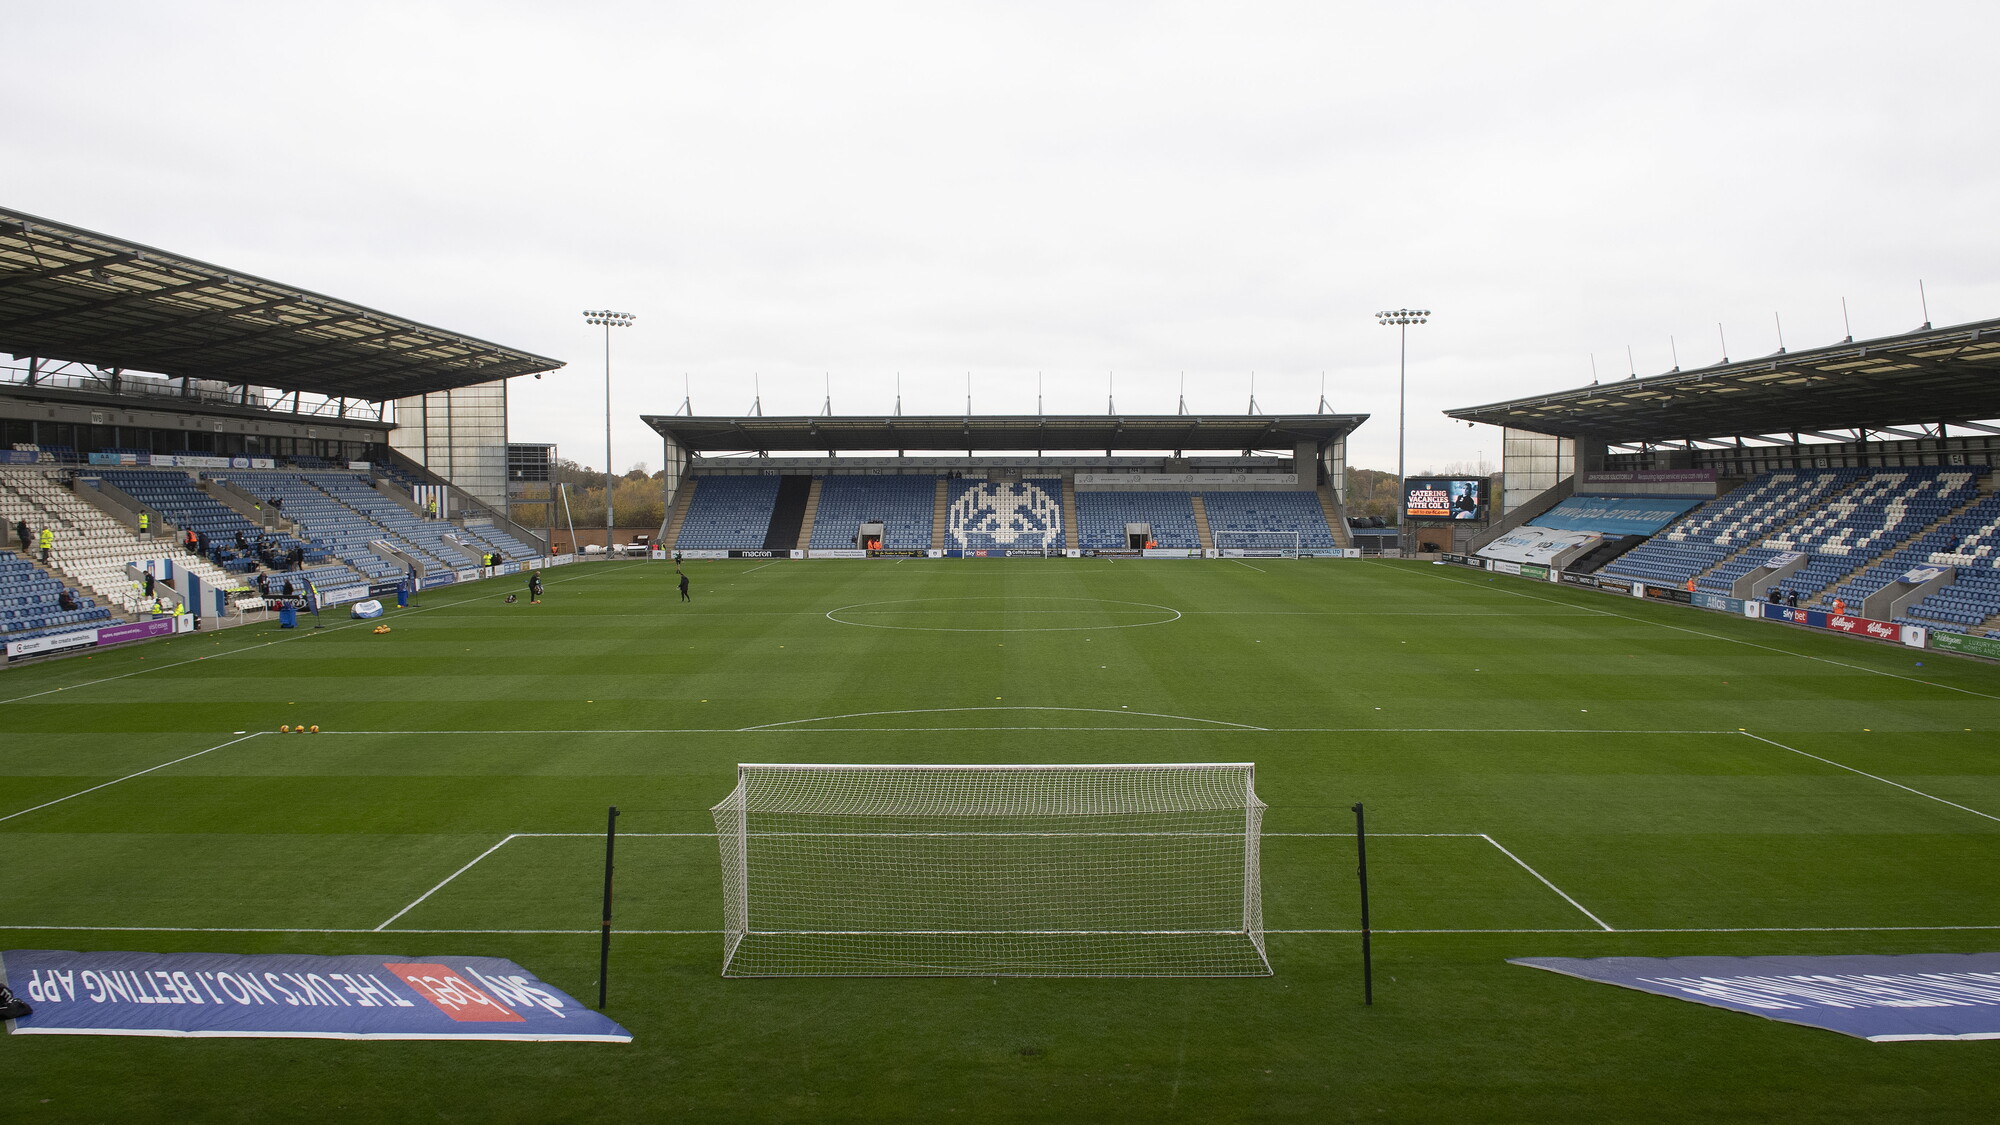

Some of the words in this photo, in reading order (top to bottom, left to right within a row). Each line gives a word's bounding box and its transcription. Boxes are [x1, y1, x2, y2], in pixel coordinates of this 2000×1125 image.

[1953, 454, 1963, 463] E4
[1706, 596, 1726, 610] Atlas
[1783, 609, 1794, 620] sky
[1795, 611, 1806, 621] bet
[1831, 616, 1856, 631] Kellogg's
[1867, 622, 1893, 637] Kellogg's
[1963, 644, 1982, 653] HOMES
[28, 969, 76, 1003] APP
[81, 970, 205, 1005] BETTING
[265, 973, 351, 1007] UK'S
[329, 974, 415, 1007] THE
[407, 976, 510, 1015] bet
[466, 967, 566, 1018] sky
